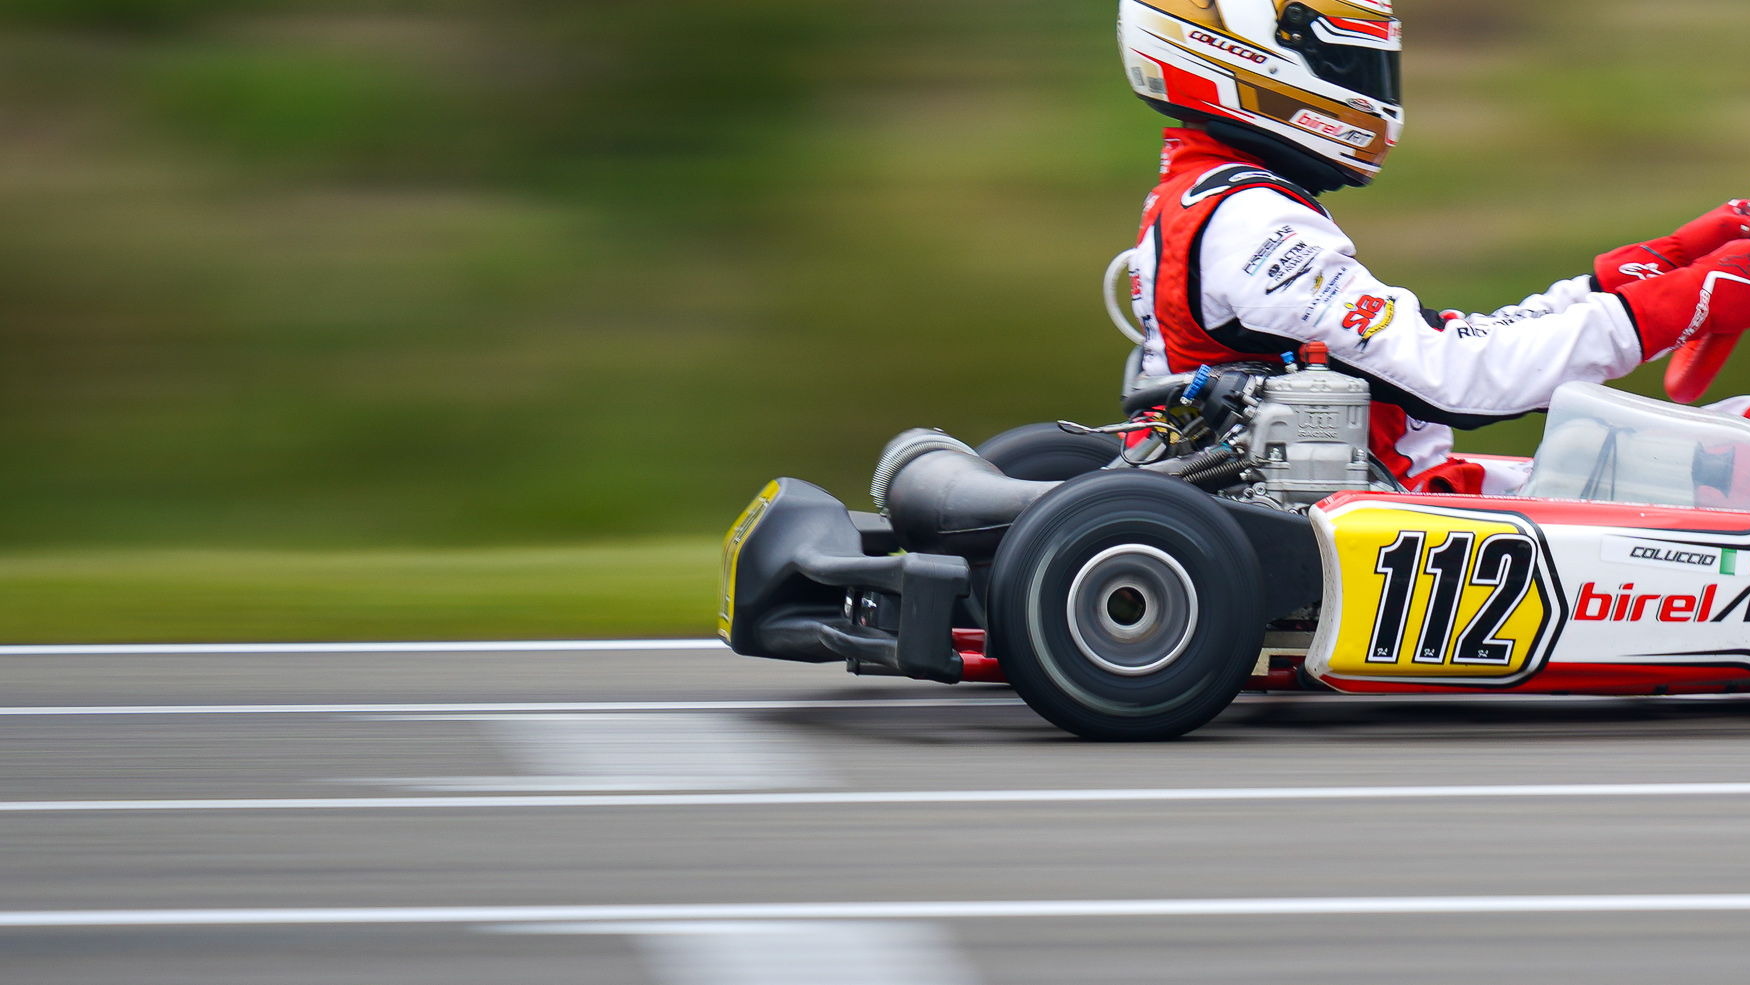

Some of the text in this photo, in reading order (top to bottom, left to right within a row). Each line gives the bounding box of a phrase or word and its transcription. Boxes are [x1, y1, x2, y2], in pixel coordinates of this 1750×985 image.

[1188, 30, 1268, 65] COLUCCIO
[1630, 547, 1717, 566] COLUCCIO
[1365, 530, 1538, 667] 112
